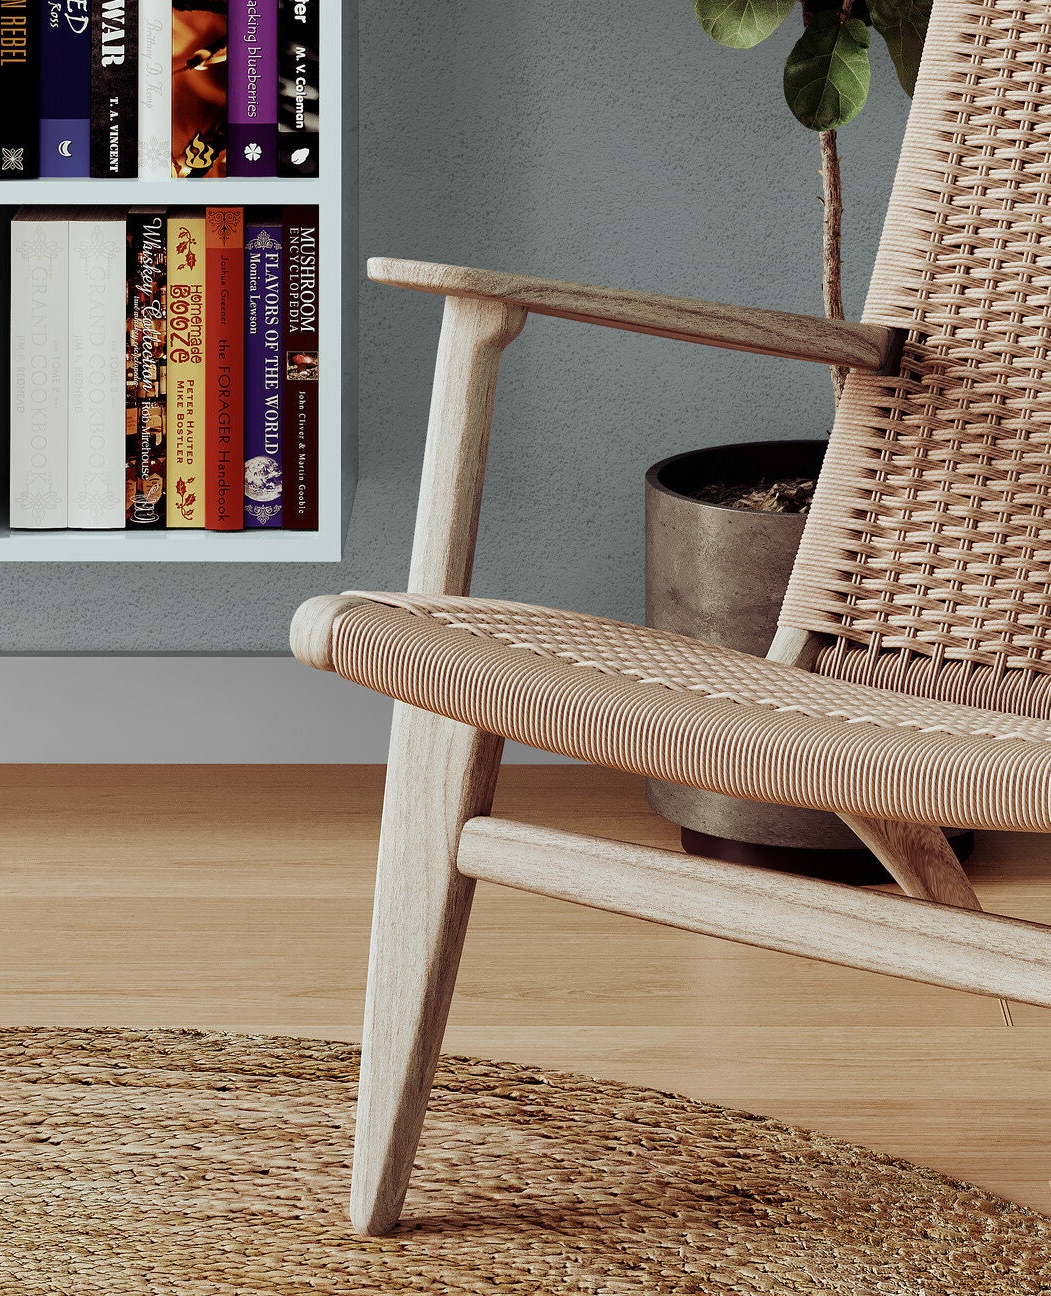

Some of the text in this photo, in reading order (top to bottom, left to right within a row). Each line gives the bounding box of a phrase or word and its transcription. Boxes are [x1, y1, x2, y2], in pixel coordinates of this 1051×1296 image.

[0, 16, 27, 66] REBEL
[48, 1, 62, 28] Ross
[247, 47, 261, 118] blueberries
[295, 46, 306, 128] M. V. Coleman
[109, 96, 118, 173] T. A. VINCENT
[135, 218, 162, 391] Whiskey Collection
[191, 284, 203, 363] Homemade
[220, 255, 229, 325] Joshua Greener
[249, 253, 260, 334] Monica Lewson
[265, 253, 279, 455] FLAVORS OF THE WORLD
[217, 339, 230, 522] the FORAGER Handbook
